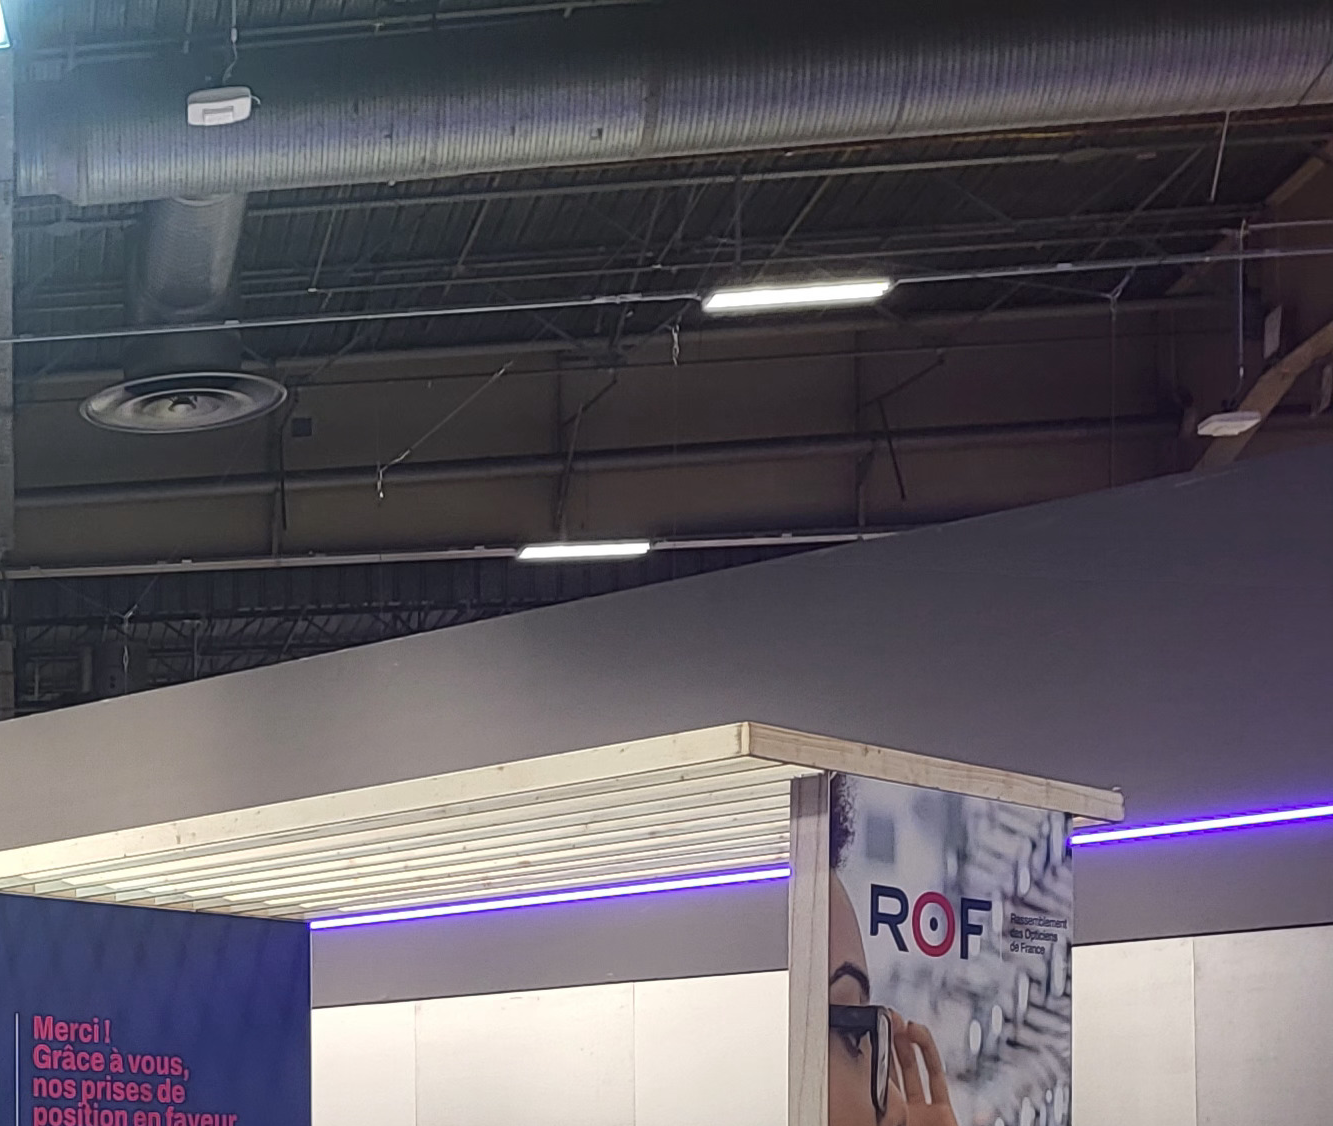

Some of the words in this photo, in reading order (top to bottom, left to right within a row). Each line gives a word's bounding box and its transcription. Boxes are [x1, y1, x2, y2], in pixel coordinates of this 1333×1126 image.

[869, 883, 992, 960] ROF
[1010, 912, 1068, 929] Rassemblement
[1009, 928, 1023, 939] des
[1025, 930, 1058, 942] Opticiens
[1009, 941, 1020, 953] de
[1021, 942, 1046, 955] France
[34, 1016, 99, 1043] Merci
[33, 1044, 104, 1071] Grâce
[110, 1048, 124, 1073] à
[129, 1055, 189, 1080] vous,
[33, 1077, 76, 1098] nos
[82, 1075, 152, 1105] prises
[158, 1078, 185, 1103] de
